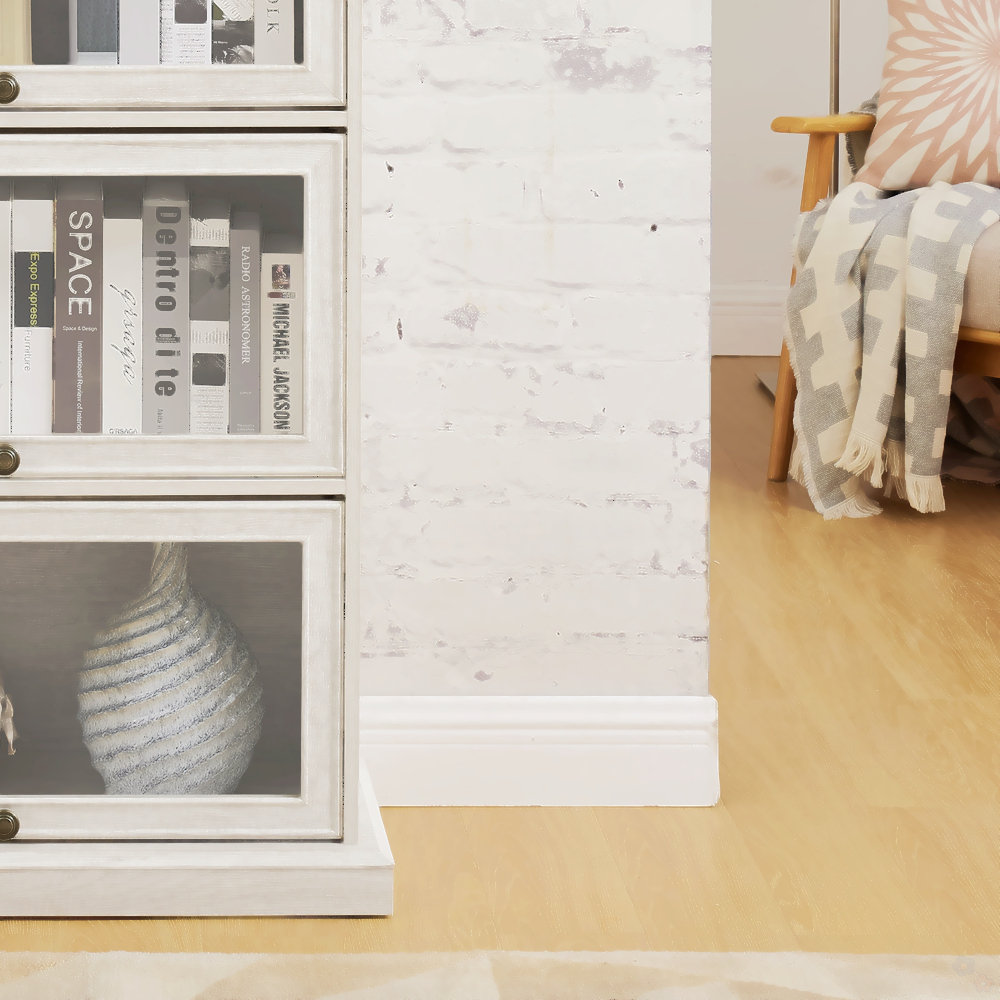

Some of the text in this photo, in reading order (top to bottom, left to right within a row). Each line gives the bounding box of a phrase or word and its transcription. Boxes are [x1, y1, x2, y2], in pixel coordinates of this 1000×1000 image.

[28, 251, 39, 327] Expo Express
[68, 210, 93, 315] SPACE
[155, 206, 181, 312] Dentro
[241, 245, 251, 364] RADIO ASTRONOMER
[272, 303, 290, 363] MICHAEL
[23, 330, 33, 371] Furniture
[272, 367, 291, 430] JACKSON
